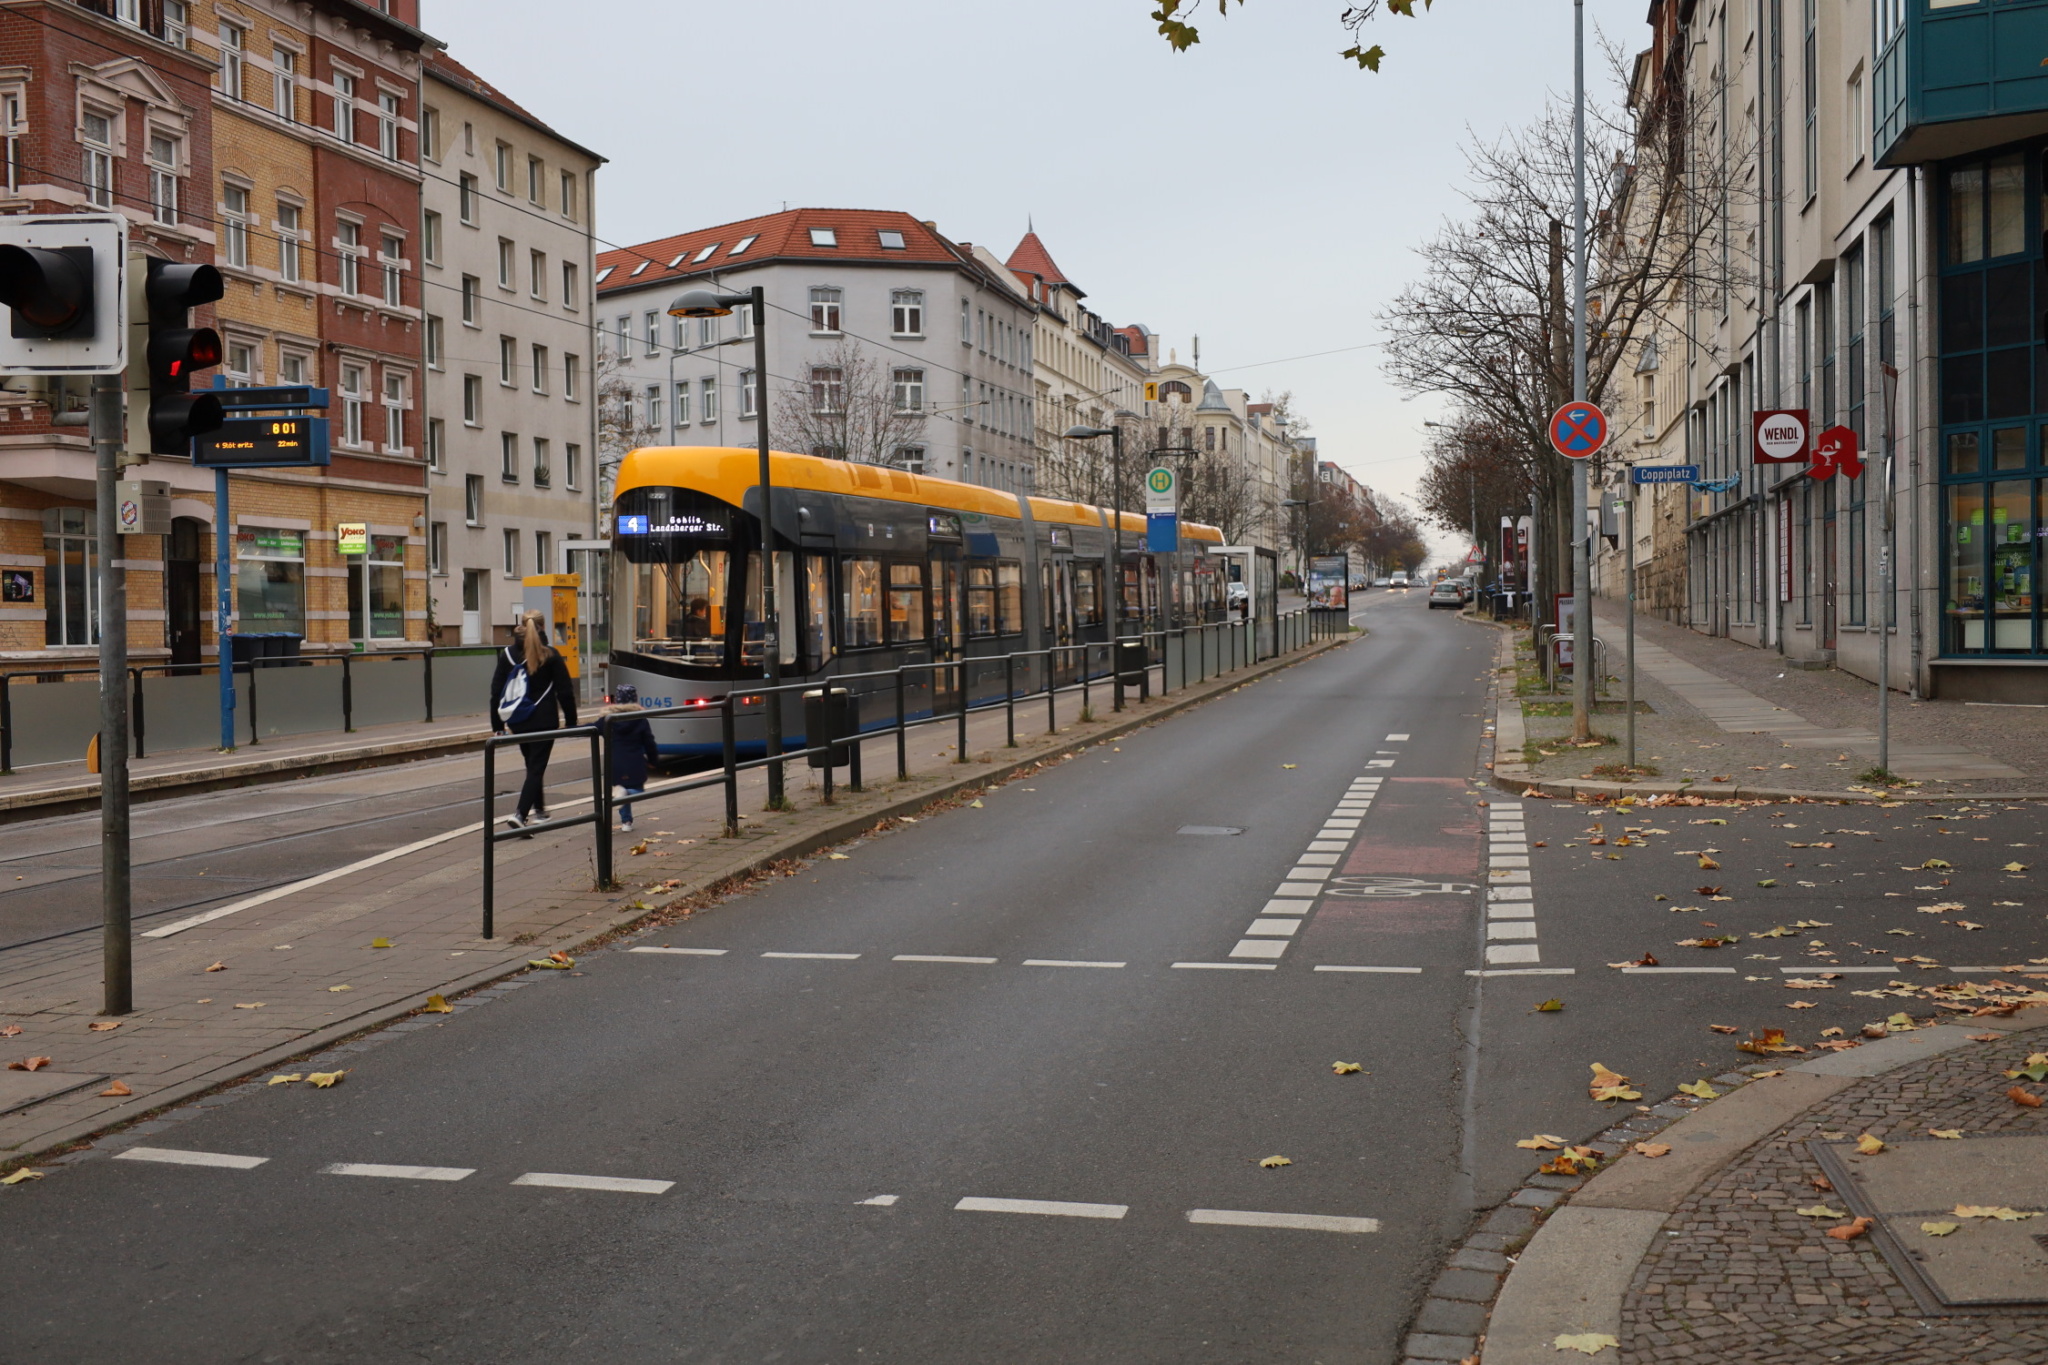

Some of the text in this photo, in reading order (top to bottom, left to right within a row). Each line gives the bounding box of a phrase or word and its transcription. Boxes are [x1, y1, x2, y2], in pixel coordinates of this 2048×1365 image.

[1147, 384, 1154, 399] 1
[1764, 427, 1799, 441] WENDL
[1641, 469, 1691, 483] Coppiplatz
[627, 517, 638, 533] 4
[706, 524, 724, 532] Str.
[640, 696, 673, 708] 1045
